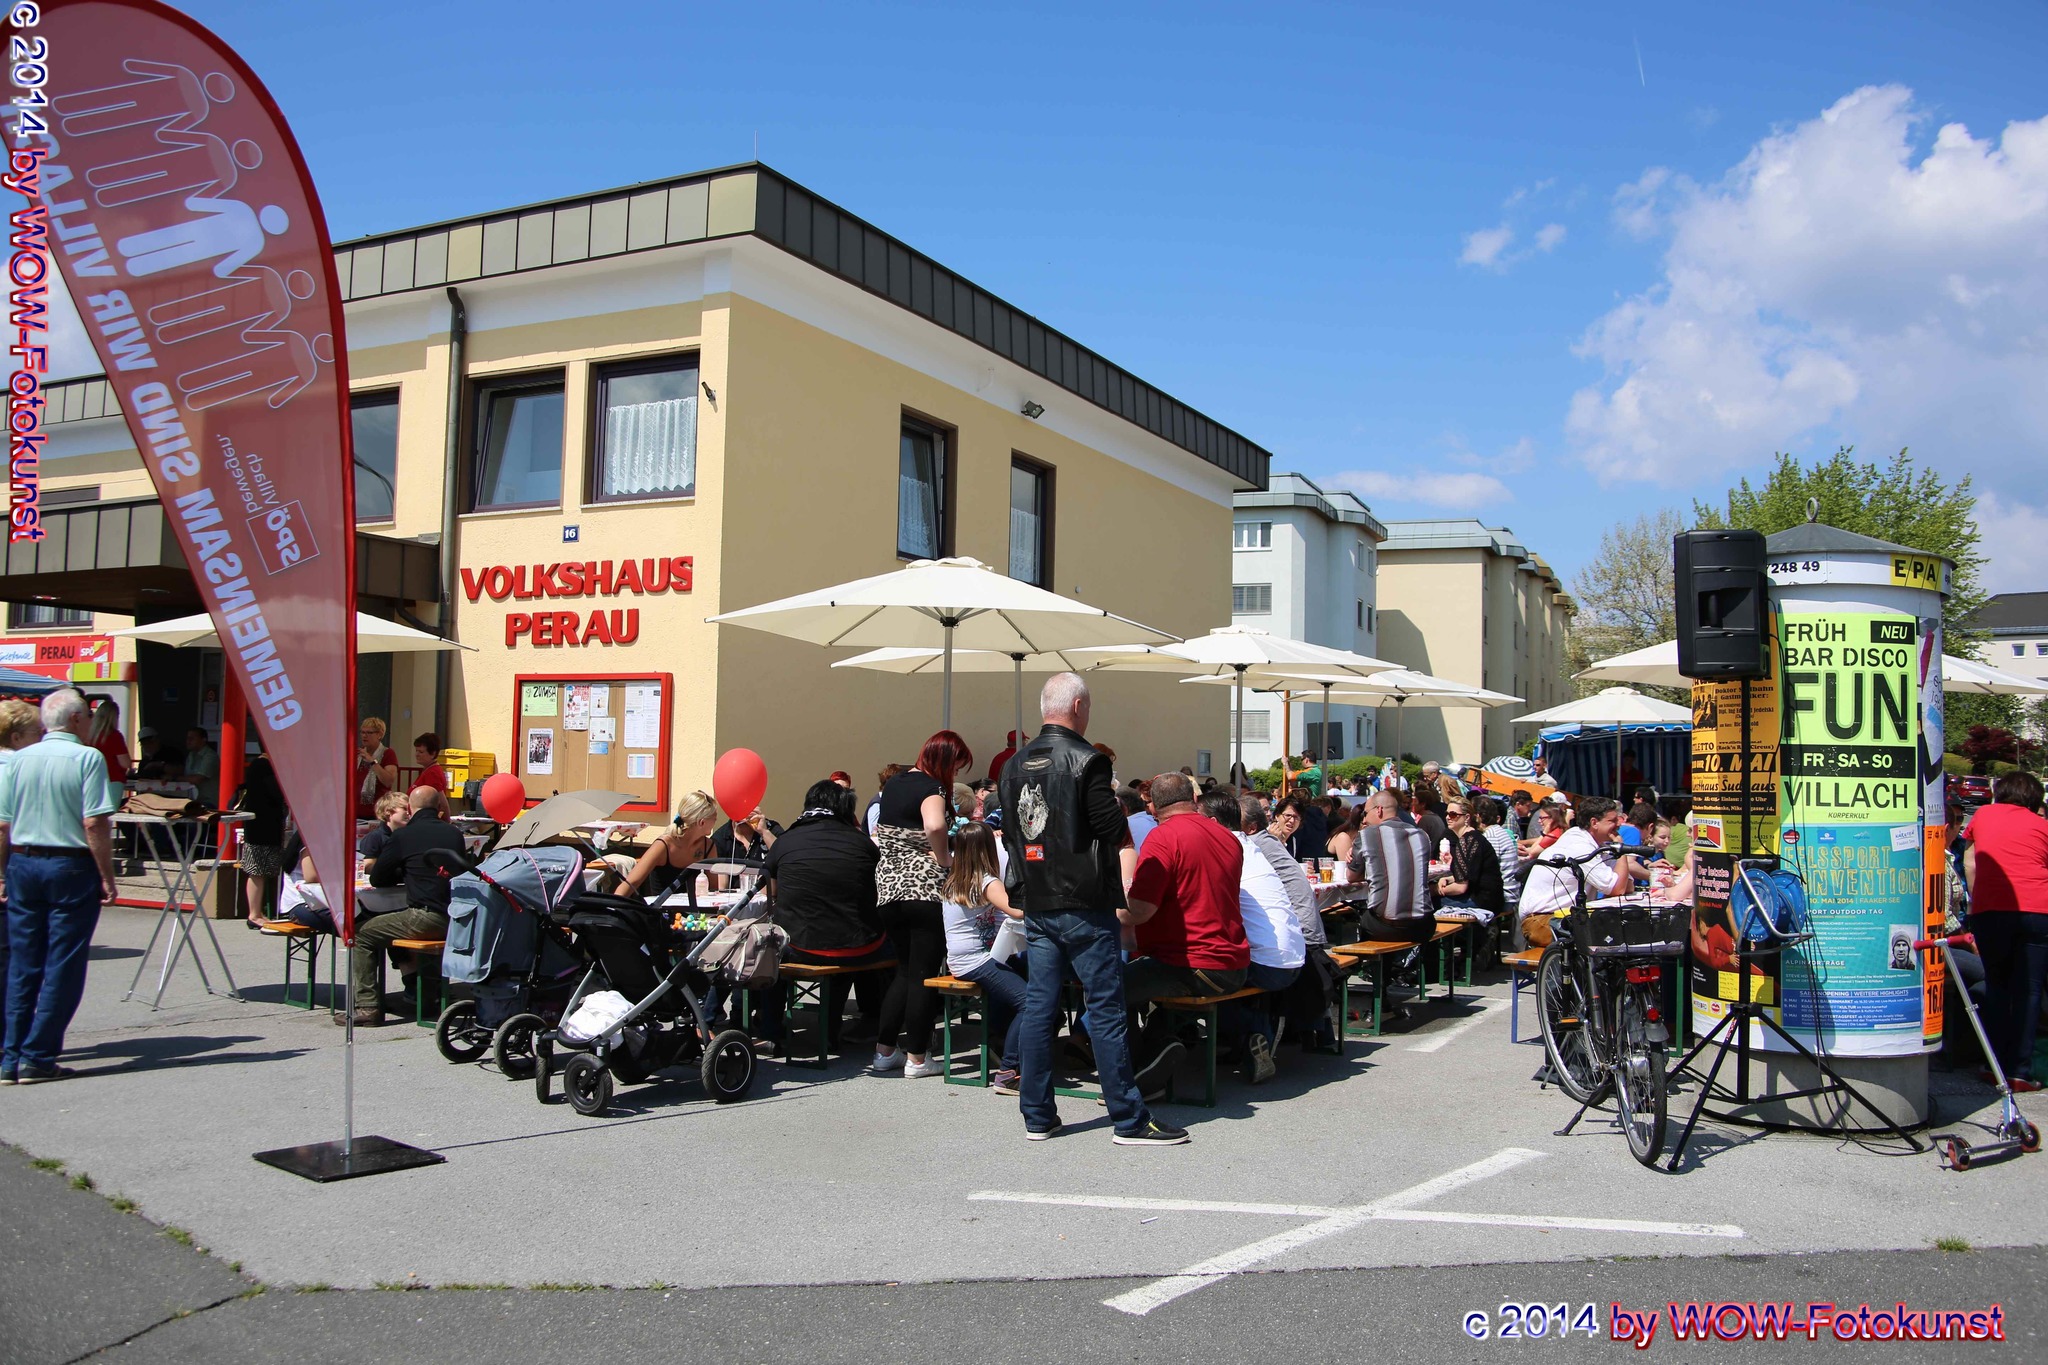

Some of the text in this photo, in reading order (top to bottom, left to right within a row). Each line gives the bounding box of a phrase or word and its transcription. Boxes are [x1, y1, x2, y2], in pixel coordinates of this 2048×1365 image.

[564, 528, 577, 539] 16
[1768, 560, 1820, 574] 248 49
[1894, 559, 1936, 582] EPA
[460, 556, 693, 600] VOLKSHAUS
[505, 608, 640, 647] PERAU
[1784, 618, 1908, 642] FRÜH NEU
[41, 646, 75, 660] PERAU
[80, 646, 95, 657] SPÖ
[1784, 647, 1908, 668] BAR DISCO
[533, 686, 556, 699] ZUMBA
[1784, 672, 1909, 741] FUN
[1705, 754, 1724, 772] 10.
[1803, 753, 1823, 767] FR
[1837, 754, 1859, 768] SA
[1872, 754, 1893, 769] SO
[1721, 779, 1776, 792] Sudaus
[1784, 780, 1908, 809] VILLACH
[1784, 845, 1891, 869] FELSSPORT
[1927, 873, 1944, 915] JU
[1869, 907, 1883, 915] TAG
